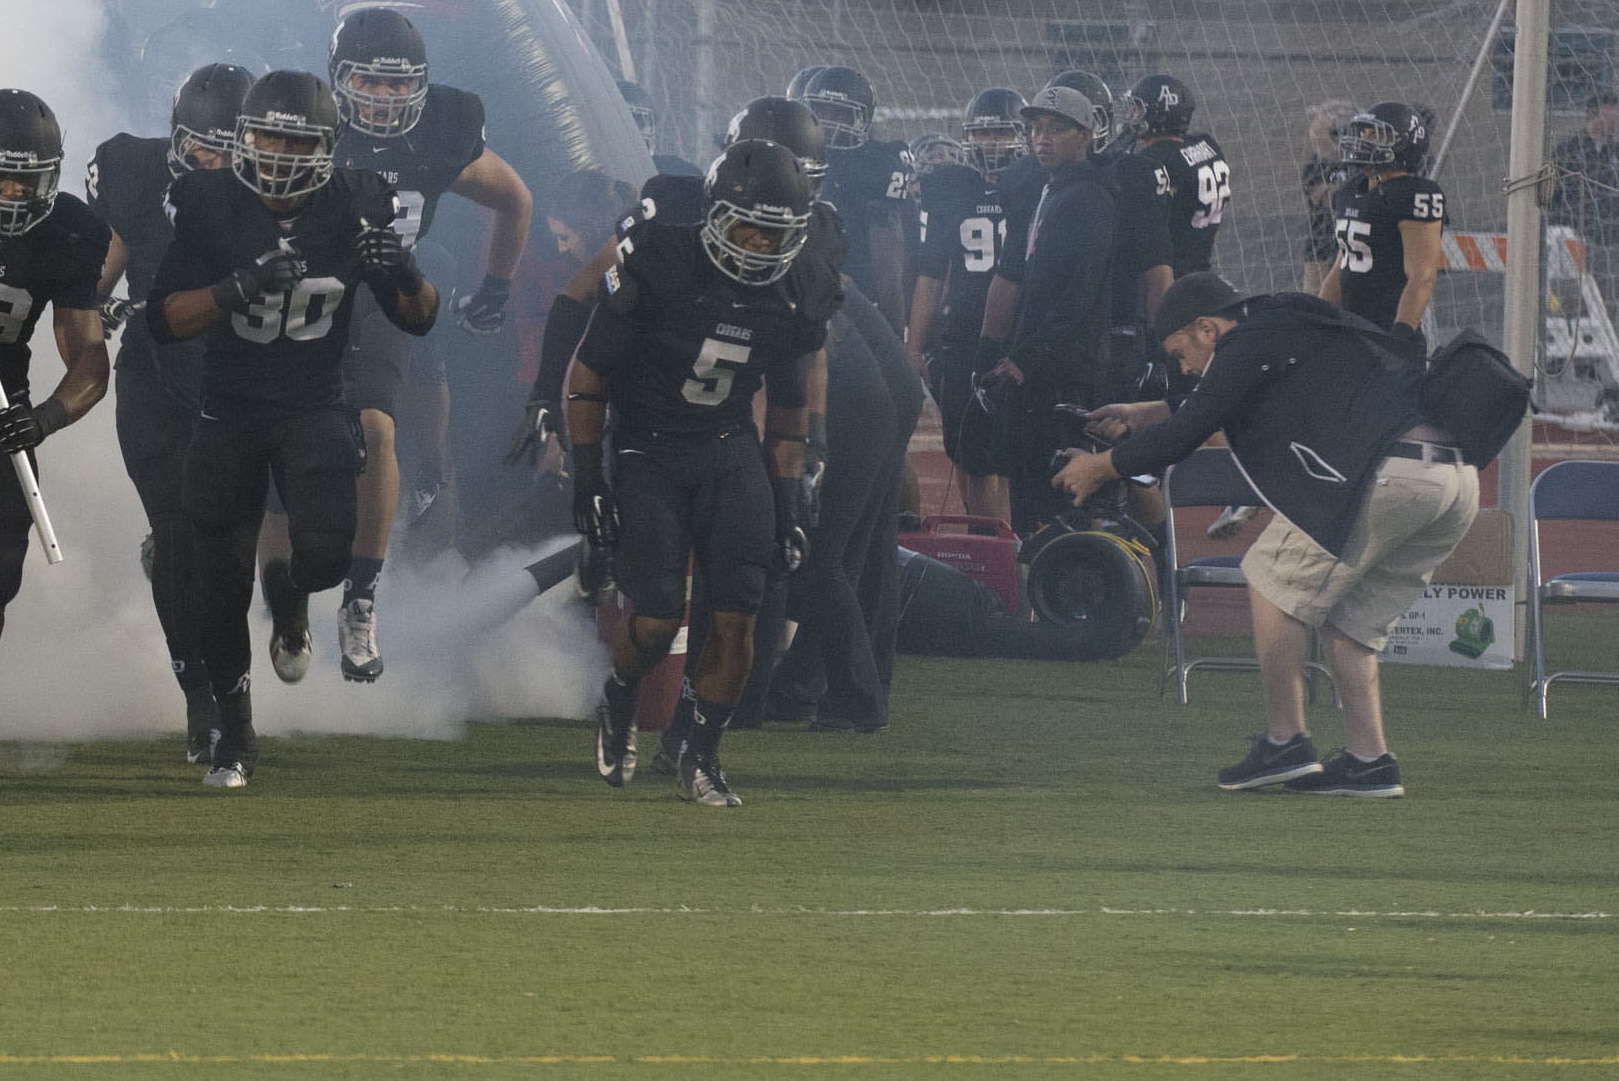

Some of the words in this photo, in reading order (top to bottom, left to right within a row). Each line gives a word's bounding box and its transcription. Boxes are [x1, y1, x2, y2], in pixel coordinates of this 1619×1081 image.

[1192, 159, 1231, 229] 92
[1413, 193, 1444, 218] 55
[1335, 219, 1374, 273] 55
[230, 276, 346, 344] 30
[681, 337, 752, 406] 5
[1423, 587, 1442, 599] LY
[1447, 587, 1507, 600] POWER
